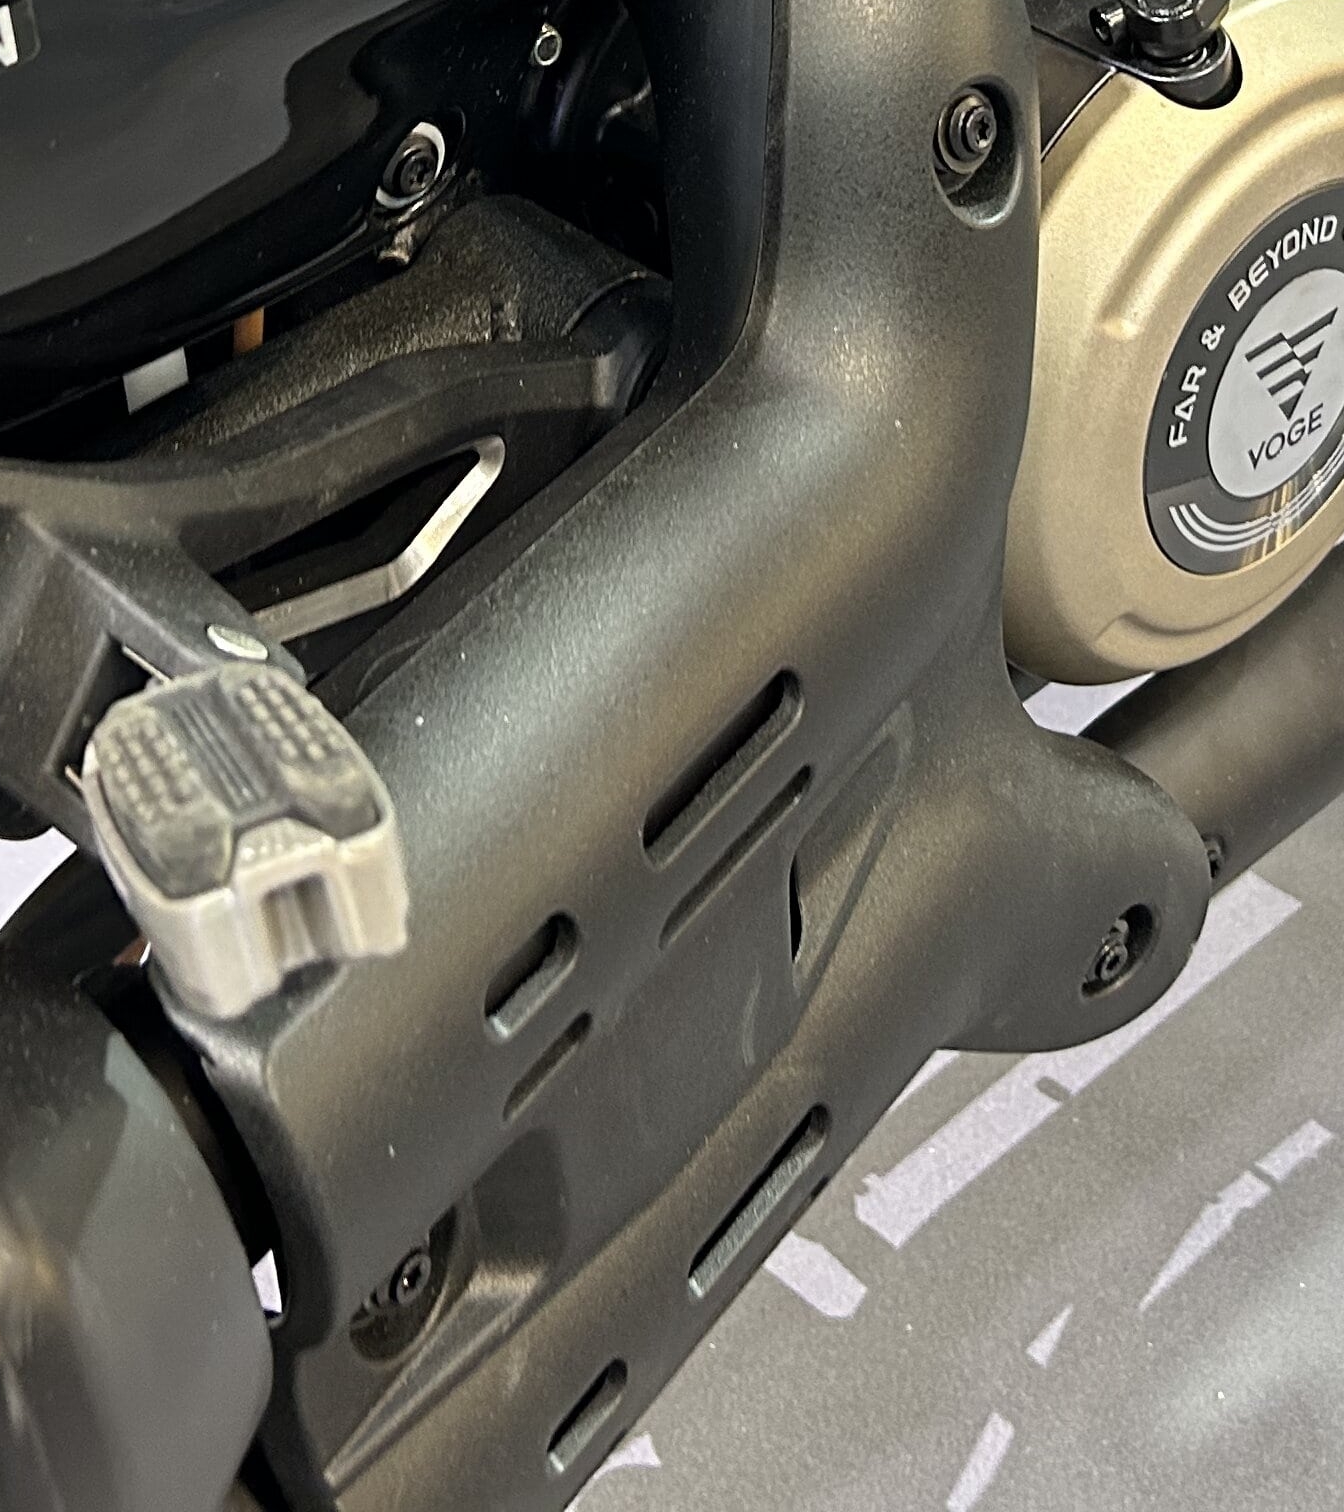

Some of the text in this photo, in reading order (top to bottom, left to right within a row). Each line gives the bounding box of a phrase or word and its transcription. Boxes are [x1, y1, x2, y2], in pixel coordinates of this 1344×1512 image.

[1169, 365, 1207, 448] FAR
[1201, 323, 1226, 351] &
[1228, 214, 1338, 311] BEYOND
[1247, 403, 1324, 470] VOGE
